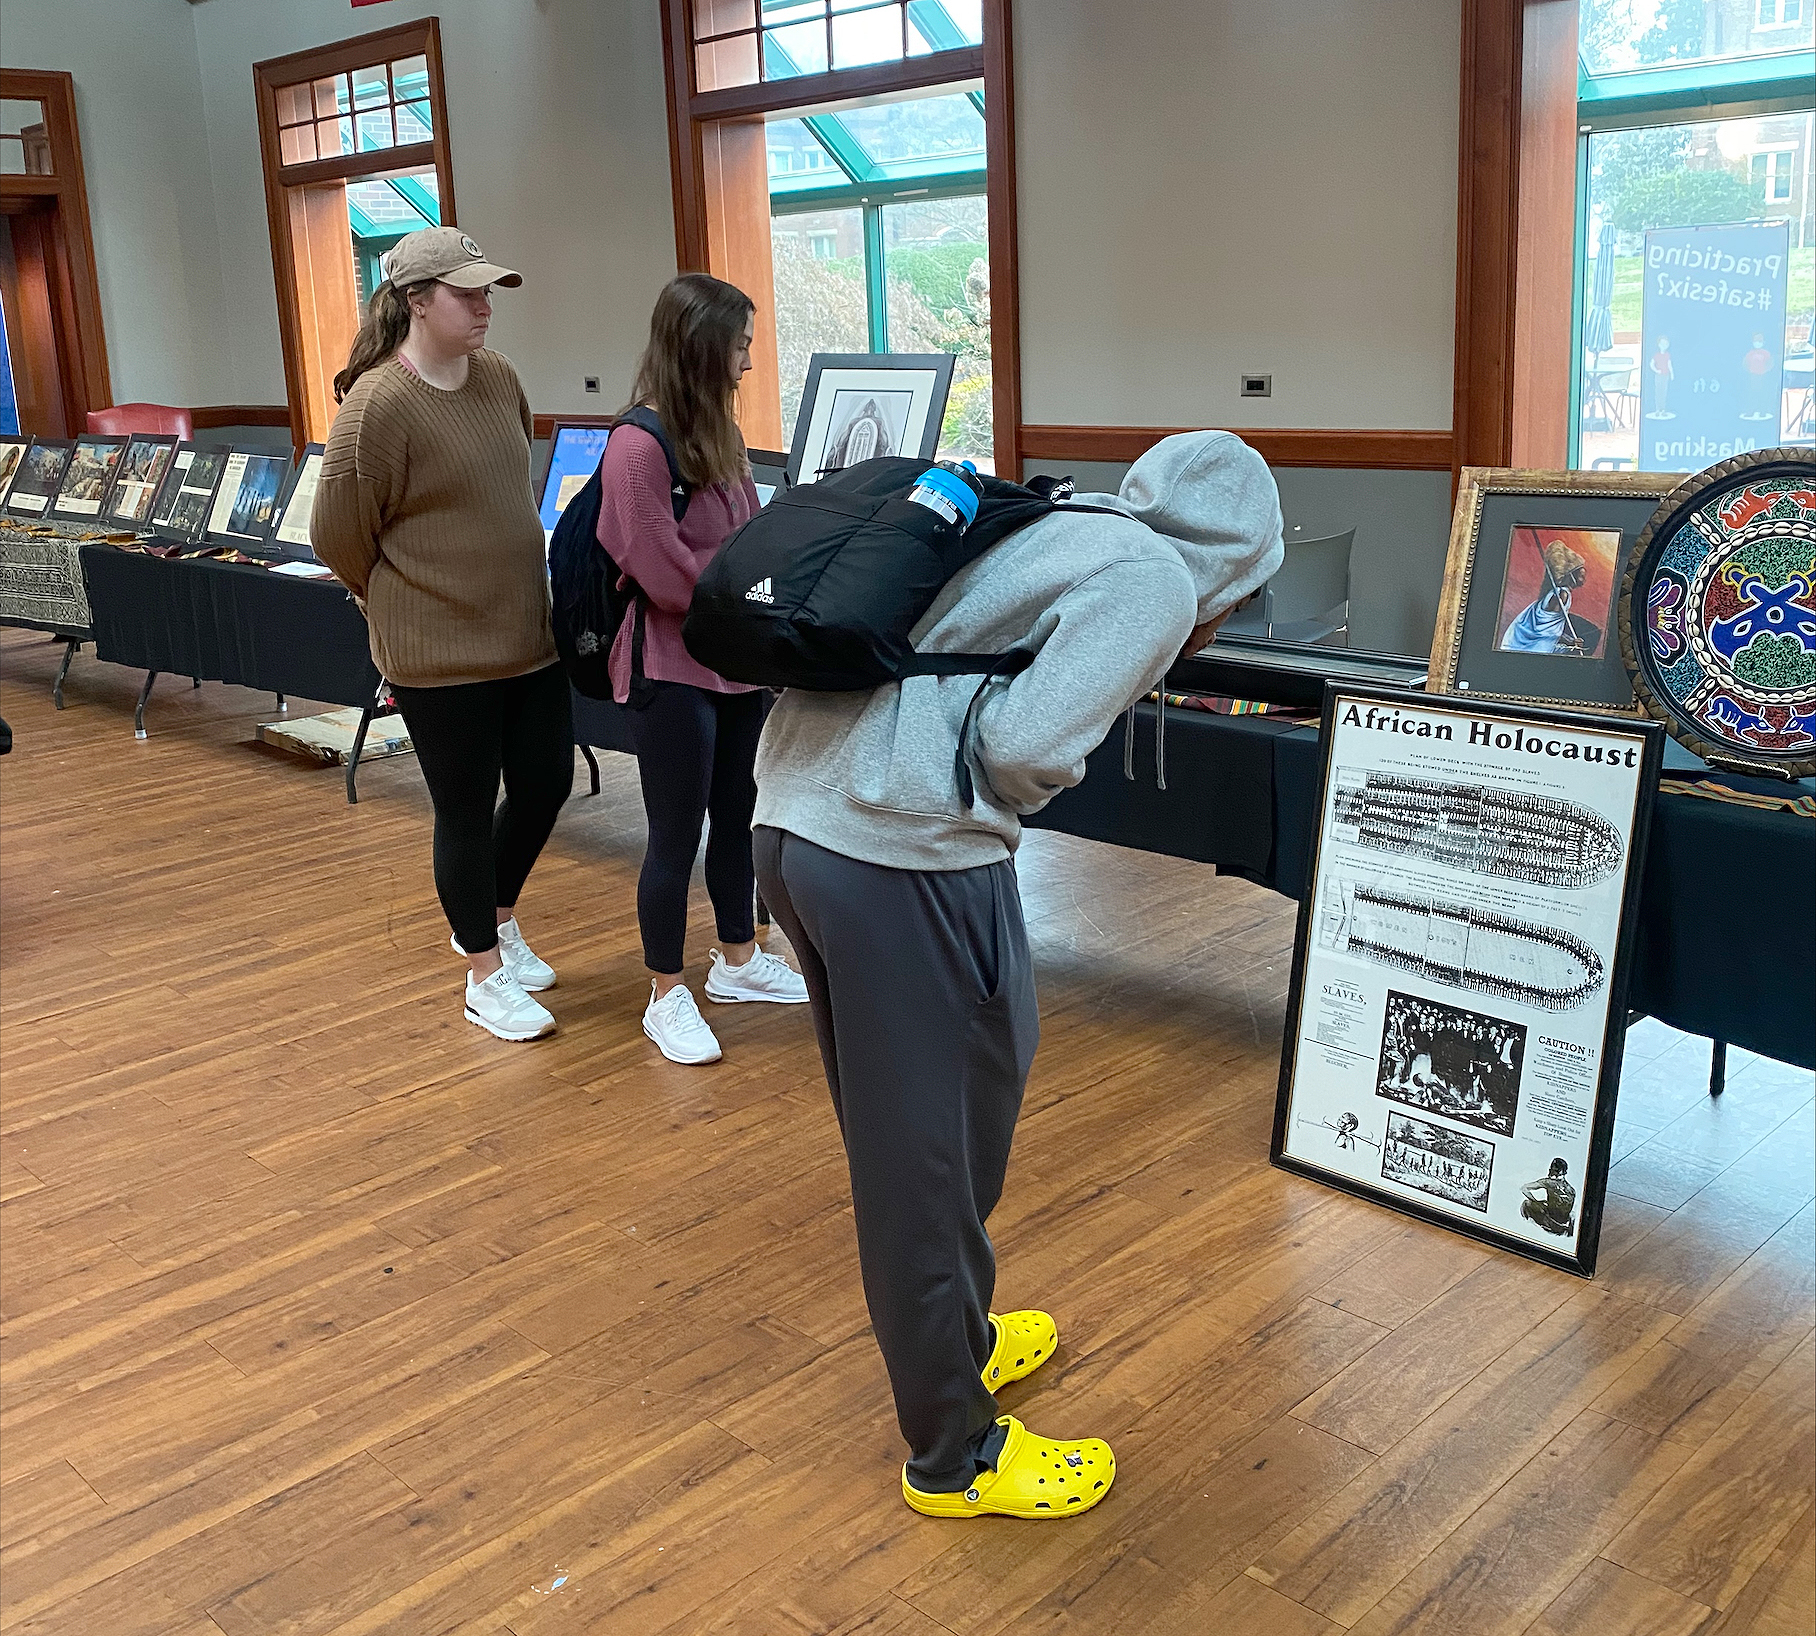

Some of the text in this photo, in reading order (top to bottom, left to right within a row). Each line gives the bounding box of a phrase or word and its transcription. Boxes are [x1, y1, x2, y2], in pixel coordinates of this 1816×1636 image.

[745, 590, 775, 605] adidas
[1341, 704, 1638, 769] African Holocaust
[1322, 984, 1367, 1006] SLAVES,
[1538, 1035, 1595, 1058] CAUTION !!
